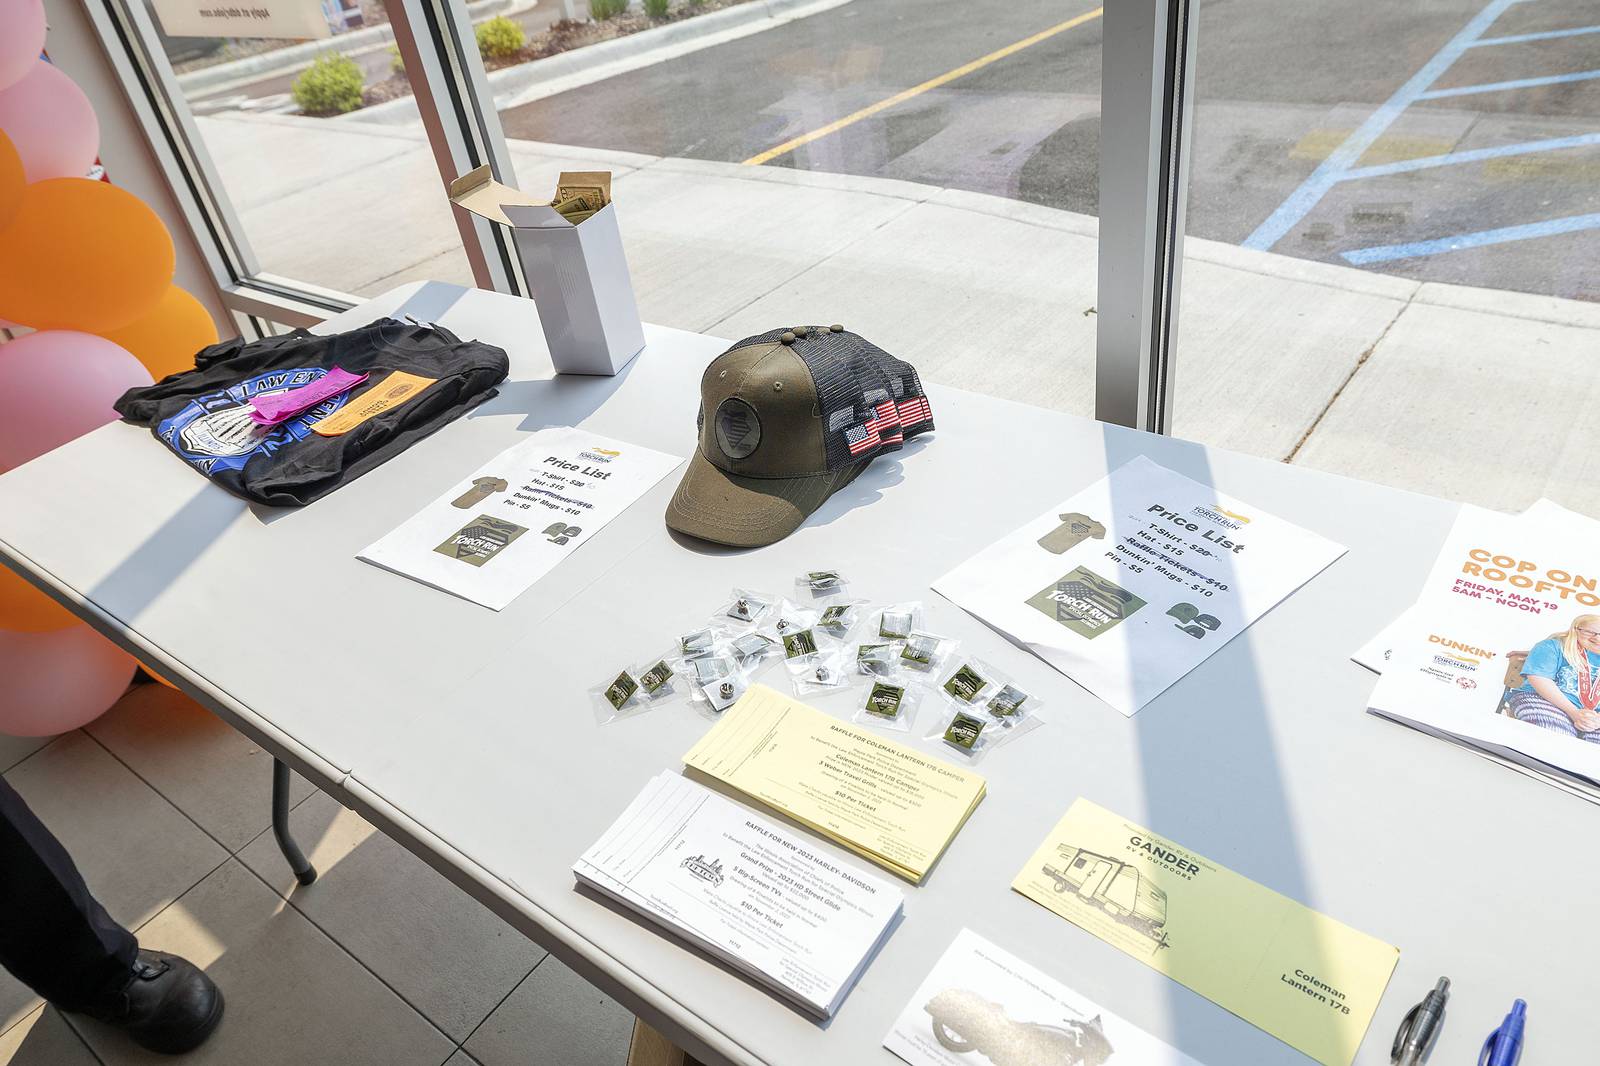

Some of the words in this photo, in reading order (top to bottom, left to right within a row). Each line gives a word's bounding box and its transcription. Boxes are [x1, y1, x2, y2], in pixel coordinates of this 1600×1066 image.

[242, 372, 289, 397] LAW
[541, 471, 566, 482] T-Shirt
[543, 456, 580, 472] Price
[581, 466, 612, 480] List
[531, 478, 545, 487] Hat
[549, 483, 565, 491] $15
[544, 490, 572, 503] Tickets
[540, 499, 560, 510] Mugs
[565, 507, 581, 516] $10
[1193, 506, 1222, 523] TORCH
[1221, 518, 1240, 530] RUN
[1147, 504, 1199, 532] Price
[1201, 529, 1245, 554] List
[1148, 523, 1183, 544] T-Shirt
[1189, 544, 1209, 558] $20
[451, 535, 483, 549] TORCH
[482, 541, 500, 552] RUN
[1137, 530, 1157, 543] Hat
[1163, 543, 1185, 557] $15
[1105, 551, 1122, 563] Pin
[1128, 564, 1144, 574] $5
[1115, 544, 1155, 566] Dunkin'
[1154, 565, 1183, 583] Mugs
[1191, 584, 1214, 598] $10
[1126, 537, 1156, 556] Raffle
[1159, 553, 1198, 577] Tickets
[1205, 578, 1229, 591] $10
[1469, 549, 1537, 573] COP
[1546, 569, 1598, 591] ON
[1045, 589, 1091, 612] TORCH
[1089, 608, 1112, 624] RUN
[1452, 586, 1482, 599] 5AM
[1495, 597, 1541, 614] NOON
[1508, 593, 1540, 605] MAY
[1543, 602, 1558, 610] 19
[1428, 634, 1497, 659] DUNKIN'
[1433, 655, 1460, 668] TORCH
[1459, 662, 1476, 672] RUN
[830, 724, 853, 736] RAFFLE
[852, 734, 866, 742] FOR
[865, 739, 896, 754] COLEMAN
[896, 751, 925, 766] LANTERN
[823, 762, 843, 773] Weber
[843, 770, 861, 781] Travel
[861, 778, 877, 788] Grills
[835, 753, 861, 767] Coleman
[860, 764, 884, 777] Lantern
[894, 779, 920, 793] Camper
[834, 790, 846, 798] $10
[845, 795, 857, 803] Per
[857, 800, 877, 811] Ticket
[744, 820, 769, 836] RAFFLE
[767, 833, 782, 843] FOR
[780, 840, 798, 852] NEW
[796, 848, 814, 860] 2023
[841, 872, 877, 894] DAVIDSON
[1126, 845, 1137, 853] RV
[1147, 855, 1193, 881] OUTDOORS
[1130, 836, 1200, 877] GANDER
[736, 868, 771, 890] Big-Screen
[769, 887, 783, 896] TVs
[739, 851, 759, 865] Grand
[757, 861, 774, 873] Prize
[777, 872, 794, 884] 2023
[793, 881, 805, 890] HD
[803, 887, 824, 901] Street
[823, 898, 842, 911] Glide
[739, 900, 753, 910] $10
[751, 907, 764, 917] Per
[762, 914, 784, 928] Ticket
[1281, 973, 1327, 1003] Lantern
[1329, 998, 1352, 1016] 17B
[1294, 968, 1347, 1001] Coleman
